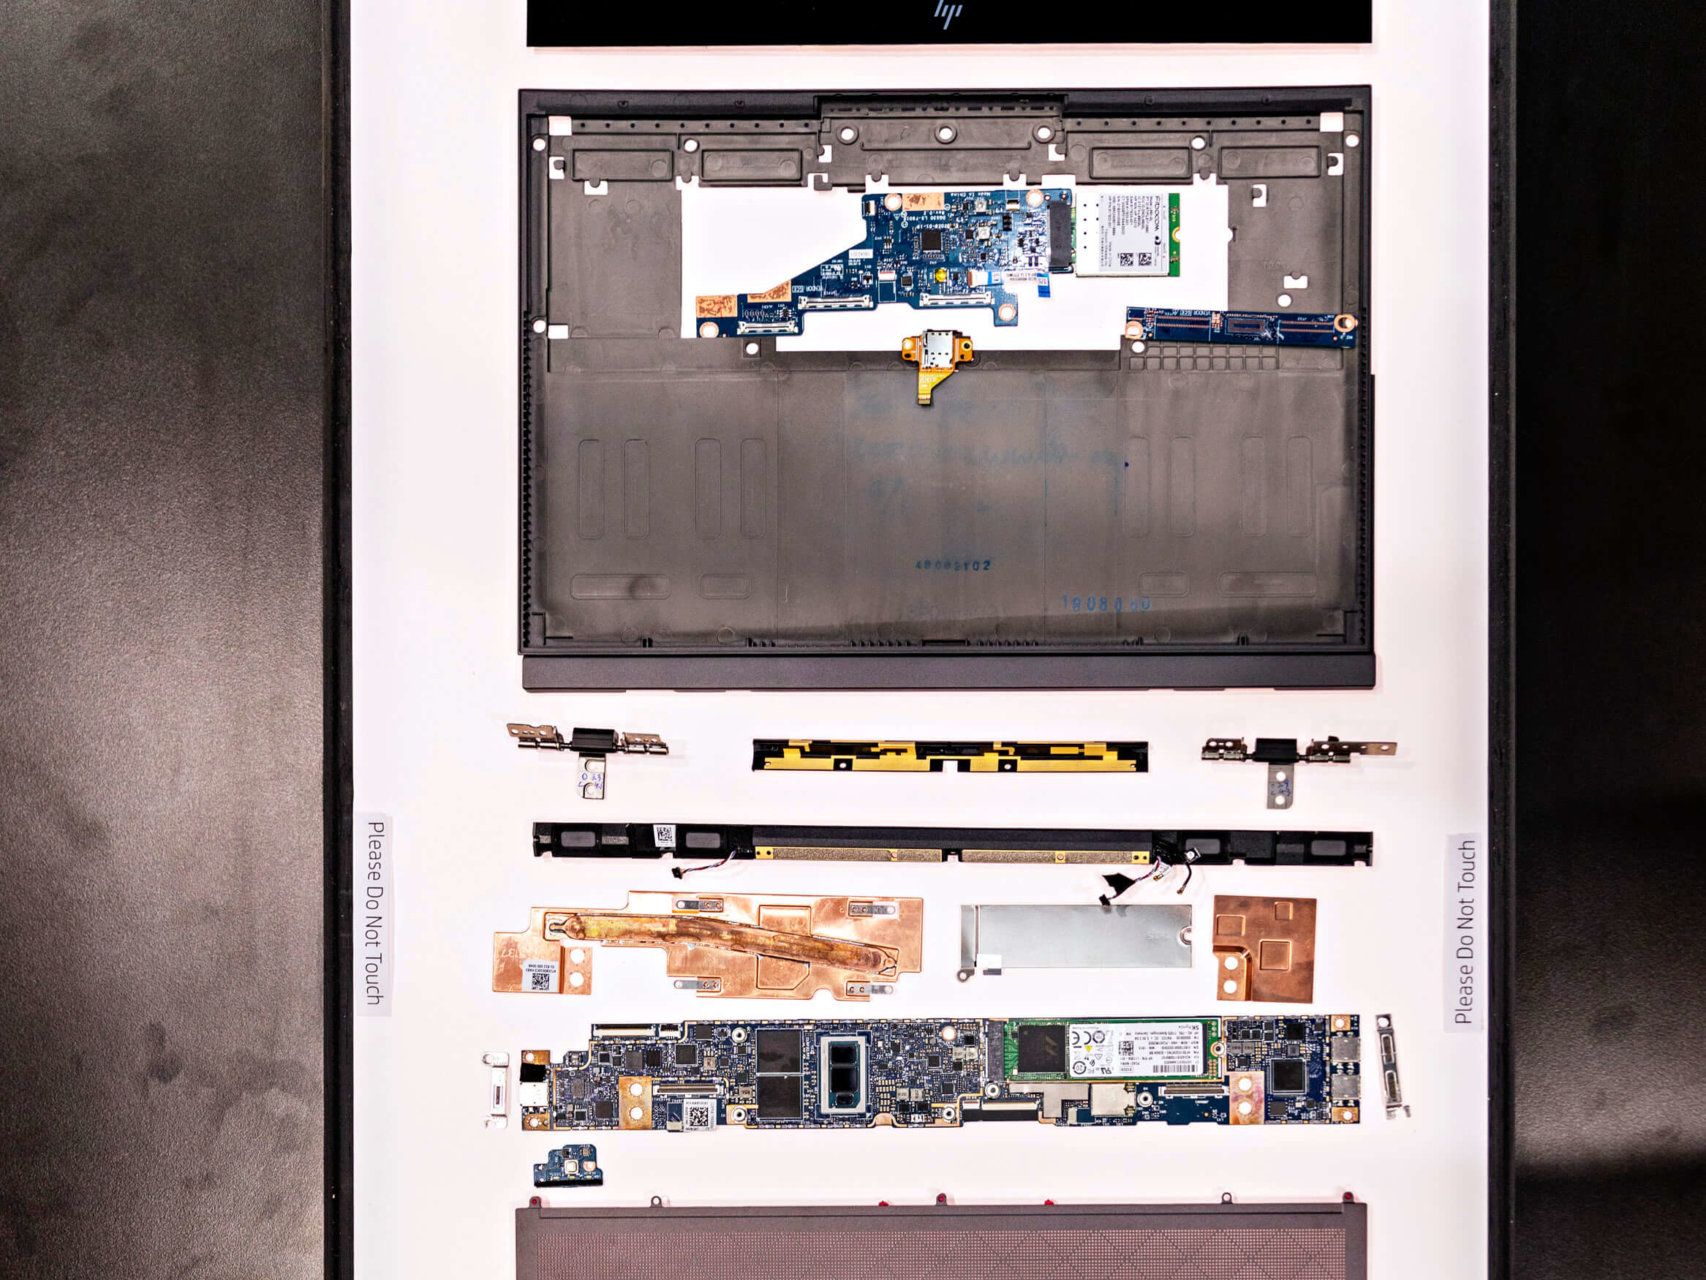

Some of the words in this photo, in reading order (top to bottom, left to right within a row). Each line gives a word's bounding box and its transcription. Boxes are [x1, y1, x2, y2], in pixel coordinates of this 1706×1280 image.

[368, 822, 385, 881] Please
[1457, 840, 1475, 893] Touch
[365, 886, 384, 910] Do
[1457, 898, 1474, 930] Not
[365, 916, 382, 947] Not
[1456, 935, 1474, 960] Do
[365, 953, 384, 1005] Touch
[1455, 964, 1474, 1024] Please
